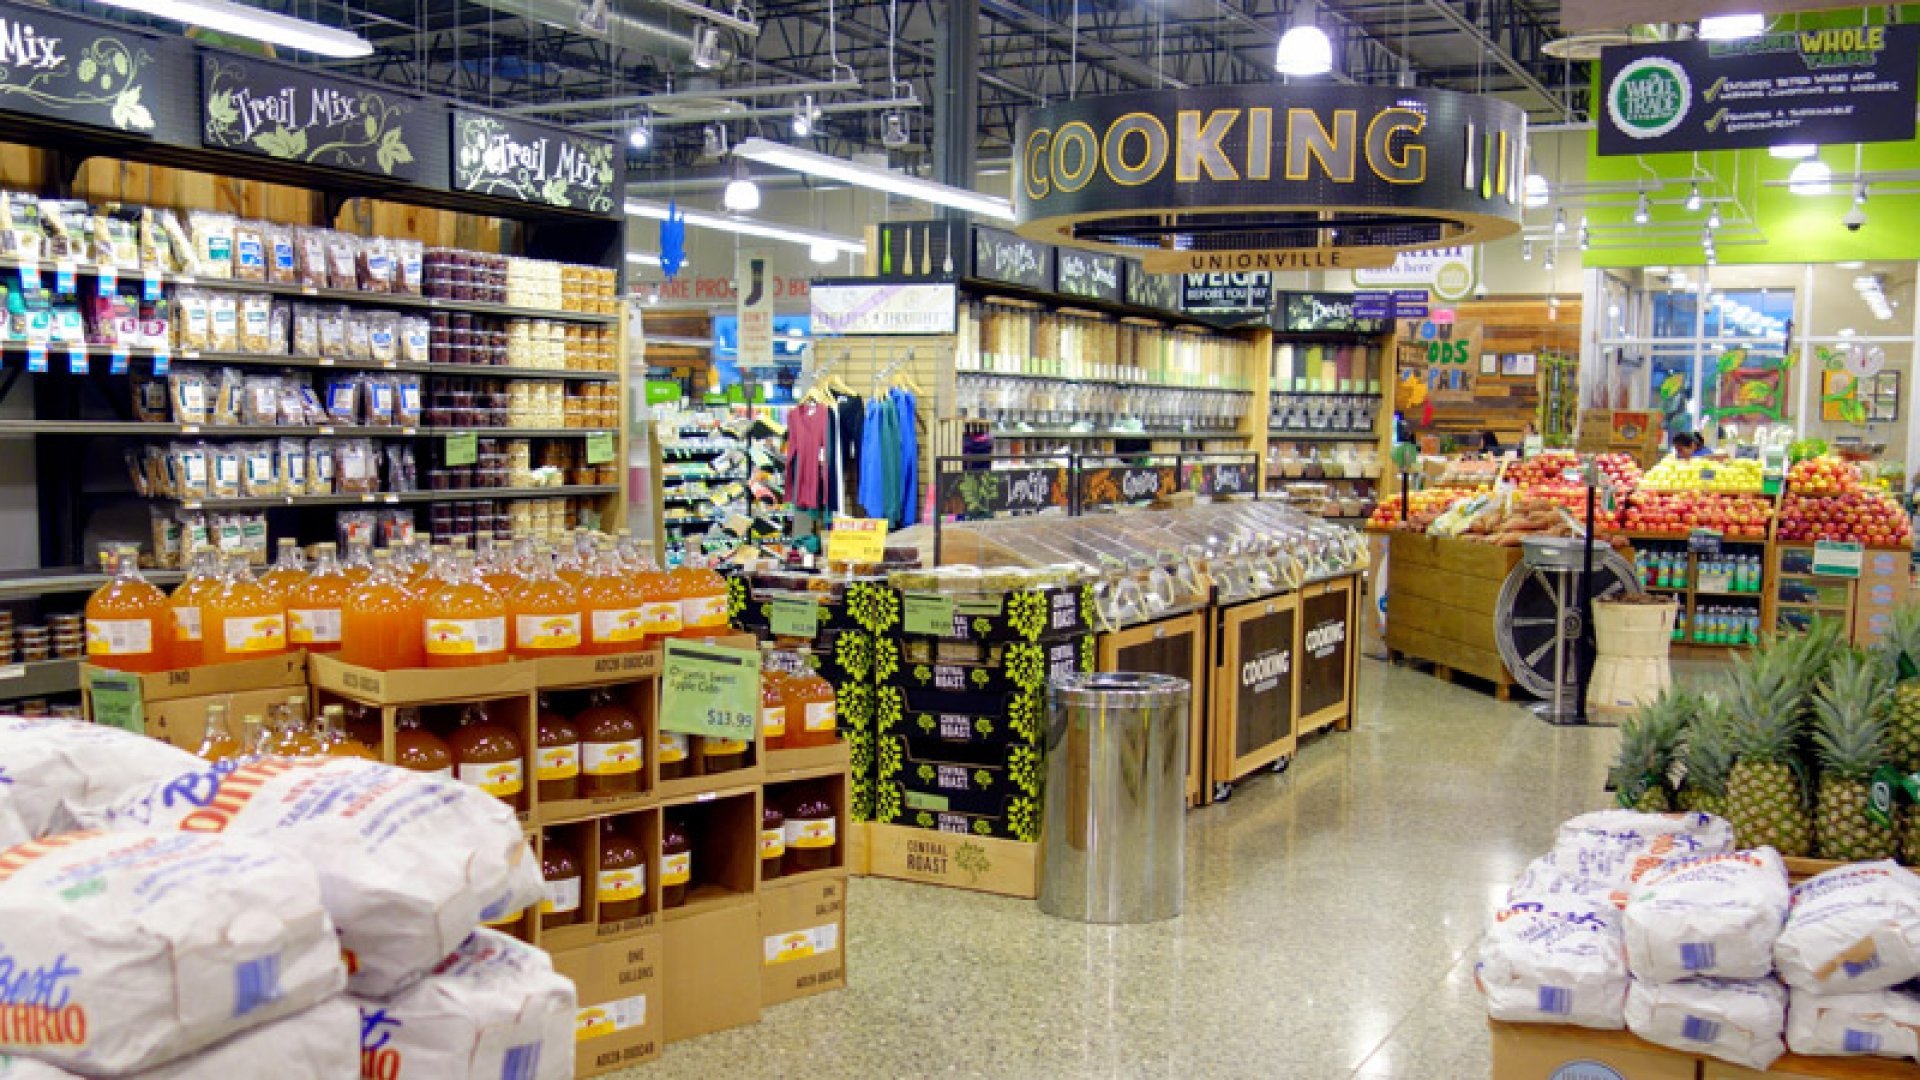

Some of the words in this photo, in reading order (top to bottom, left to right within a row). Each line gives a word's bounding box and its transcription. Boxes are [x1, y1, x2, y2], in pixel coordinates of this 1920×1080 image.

[0, 18, 66, 69] Mix
[1800, 27, 1885, 54] WHOLE
[1625, 72, 1678, 98] WHOLE
[233, 88, 297, 141] Trail
[305, 88, 358, 128] Mix
[1624, 97, 1677, 120] TRADE
[491, 134, 548, 181] Trail
[552, 142, 598, 188] Mix
[1025, 108, 1428, 200] COOKING
[1190, 251, 1341, 271] UNIONVILLE
[695, 276, 738, 299] PRO
[1427, 340, 1470, 365] ODS
[1305, 621, 1345, 652] COOKING
[1243, 650, 1289, 687] COOKING
[907, 839, 948, 859] CENTRAL
[906, 854, 949, 875] ROAST
[0, 1003, 87, 1045] TARIO
